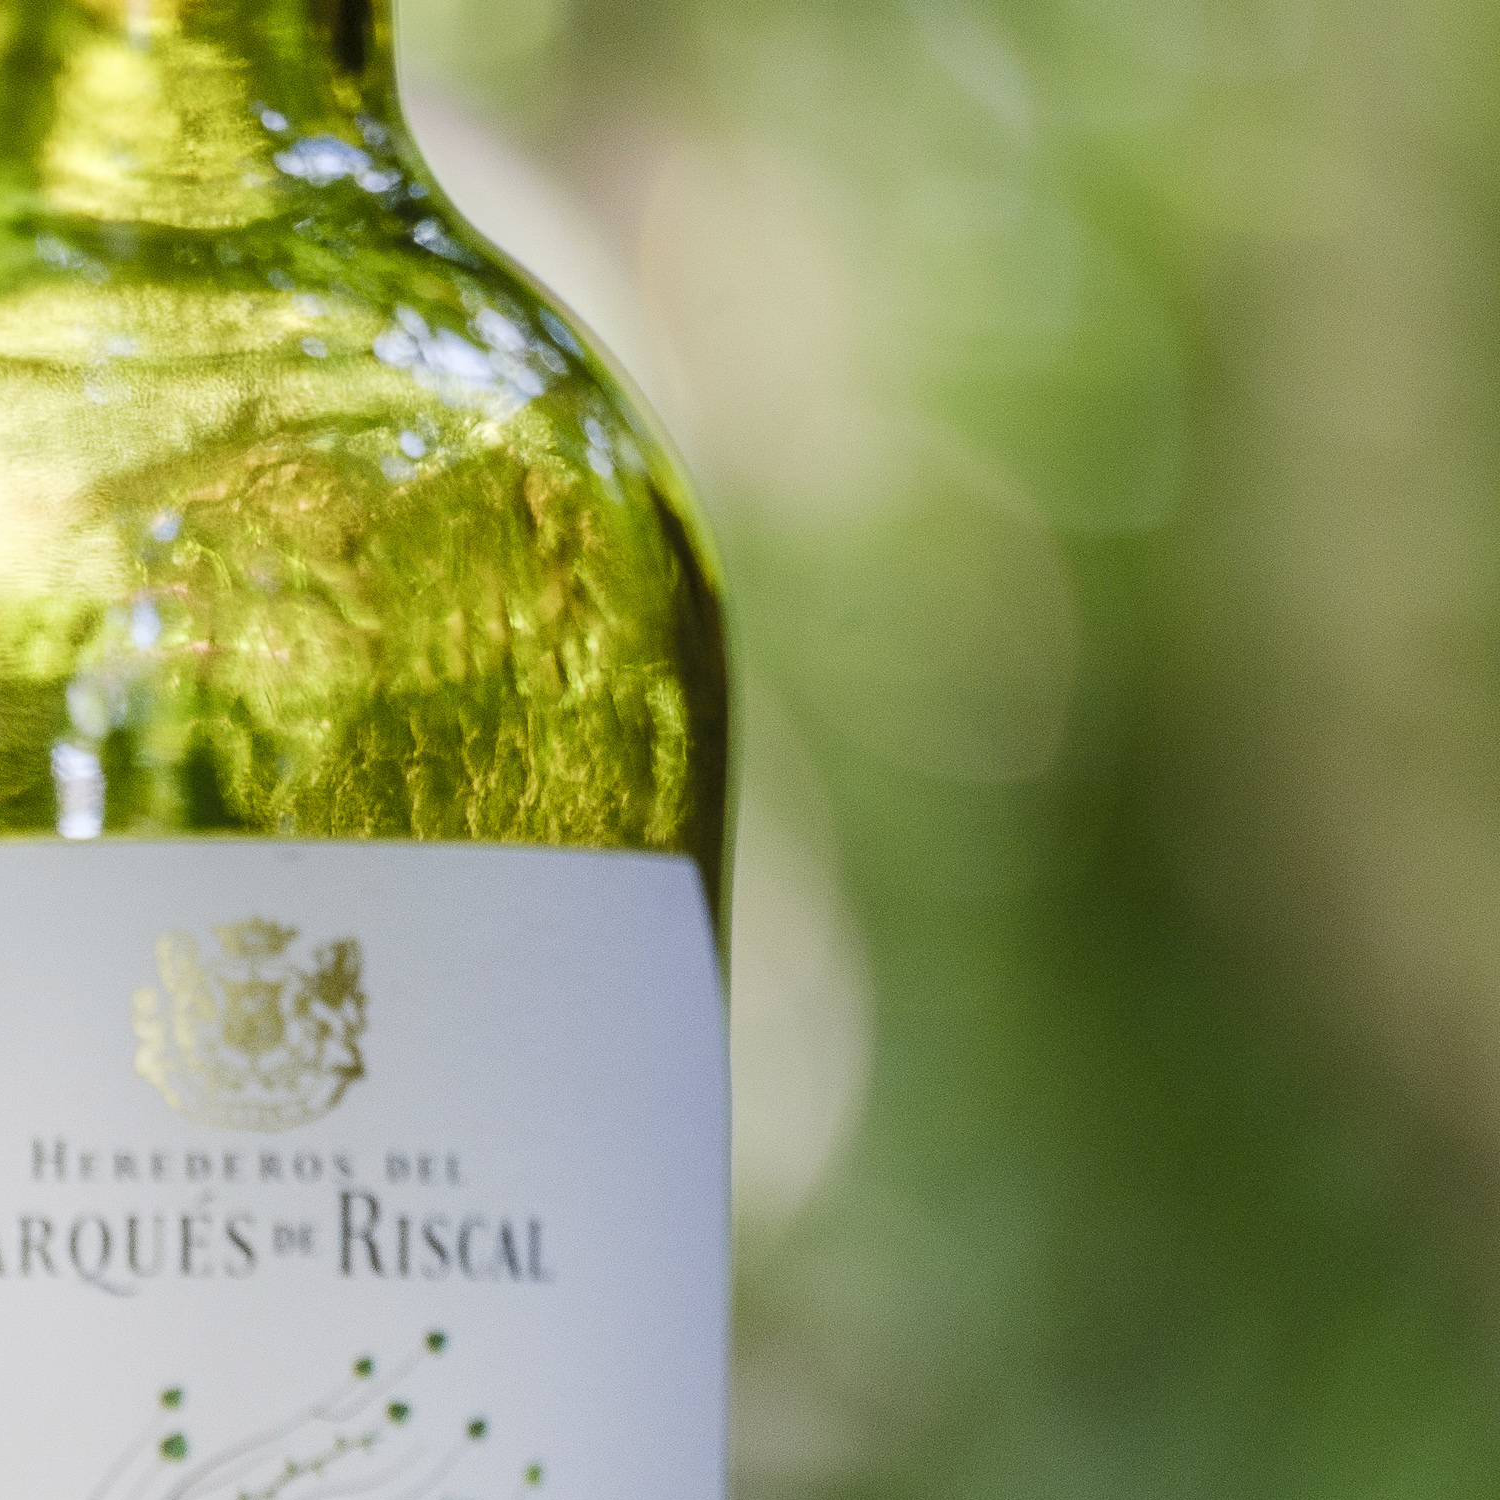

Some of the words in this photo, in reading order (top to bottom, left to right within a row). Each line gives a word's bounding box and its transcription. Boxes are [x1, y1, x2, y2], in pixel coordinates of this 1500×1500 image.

[31, 1138, 355, 1183] HEREDEROS
[386, 1150, 462, 1186] DEL
[338, 1188, 557, 1284] RISCAL
